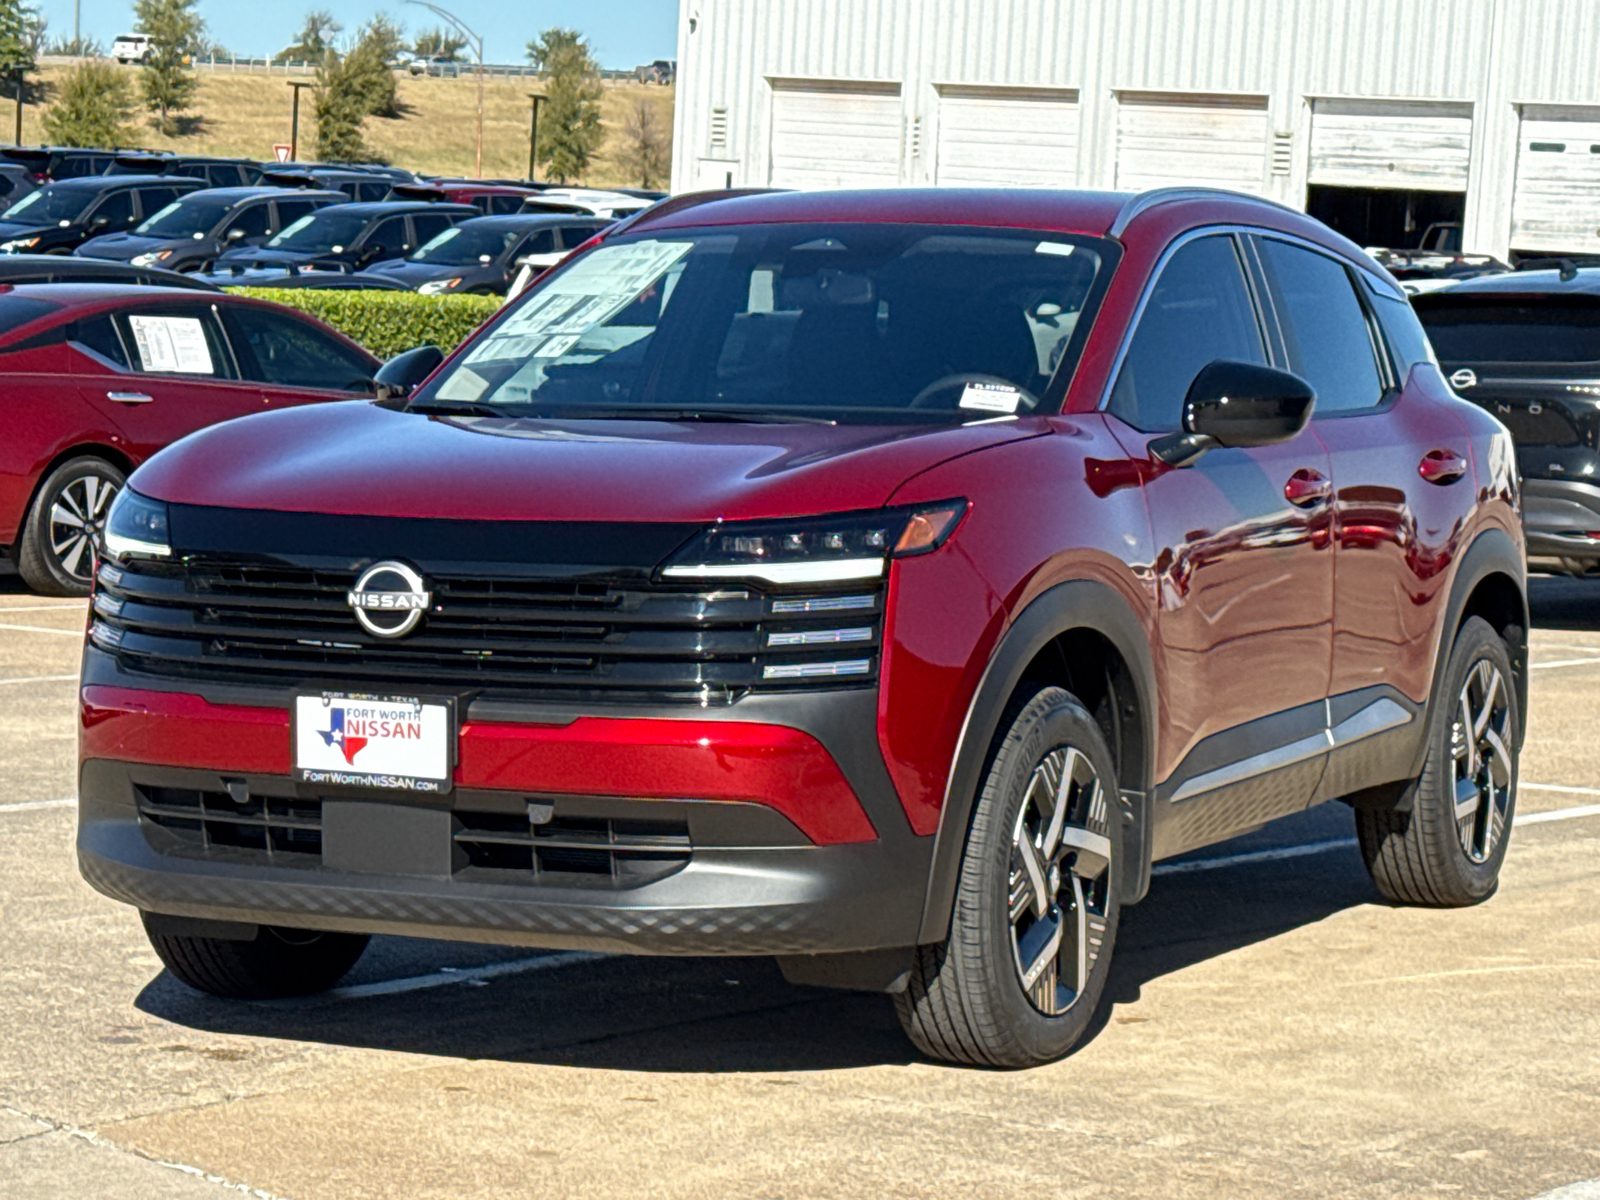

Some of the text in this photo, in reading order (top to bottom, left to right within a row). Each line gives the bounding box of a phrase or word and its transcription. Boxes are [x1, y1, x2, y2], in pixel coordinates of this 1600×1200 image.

[348, 592, 428, 609] NISSAN
[346, 708, 421, 722] FORT WORTH
[347, 719, 421, 740] NISSAN
